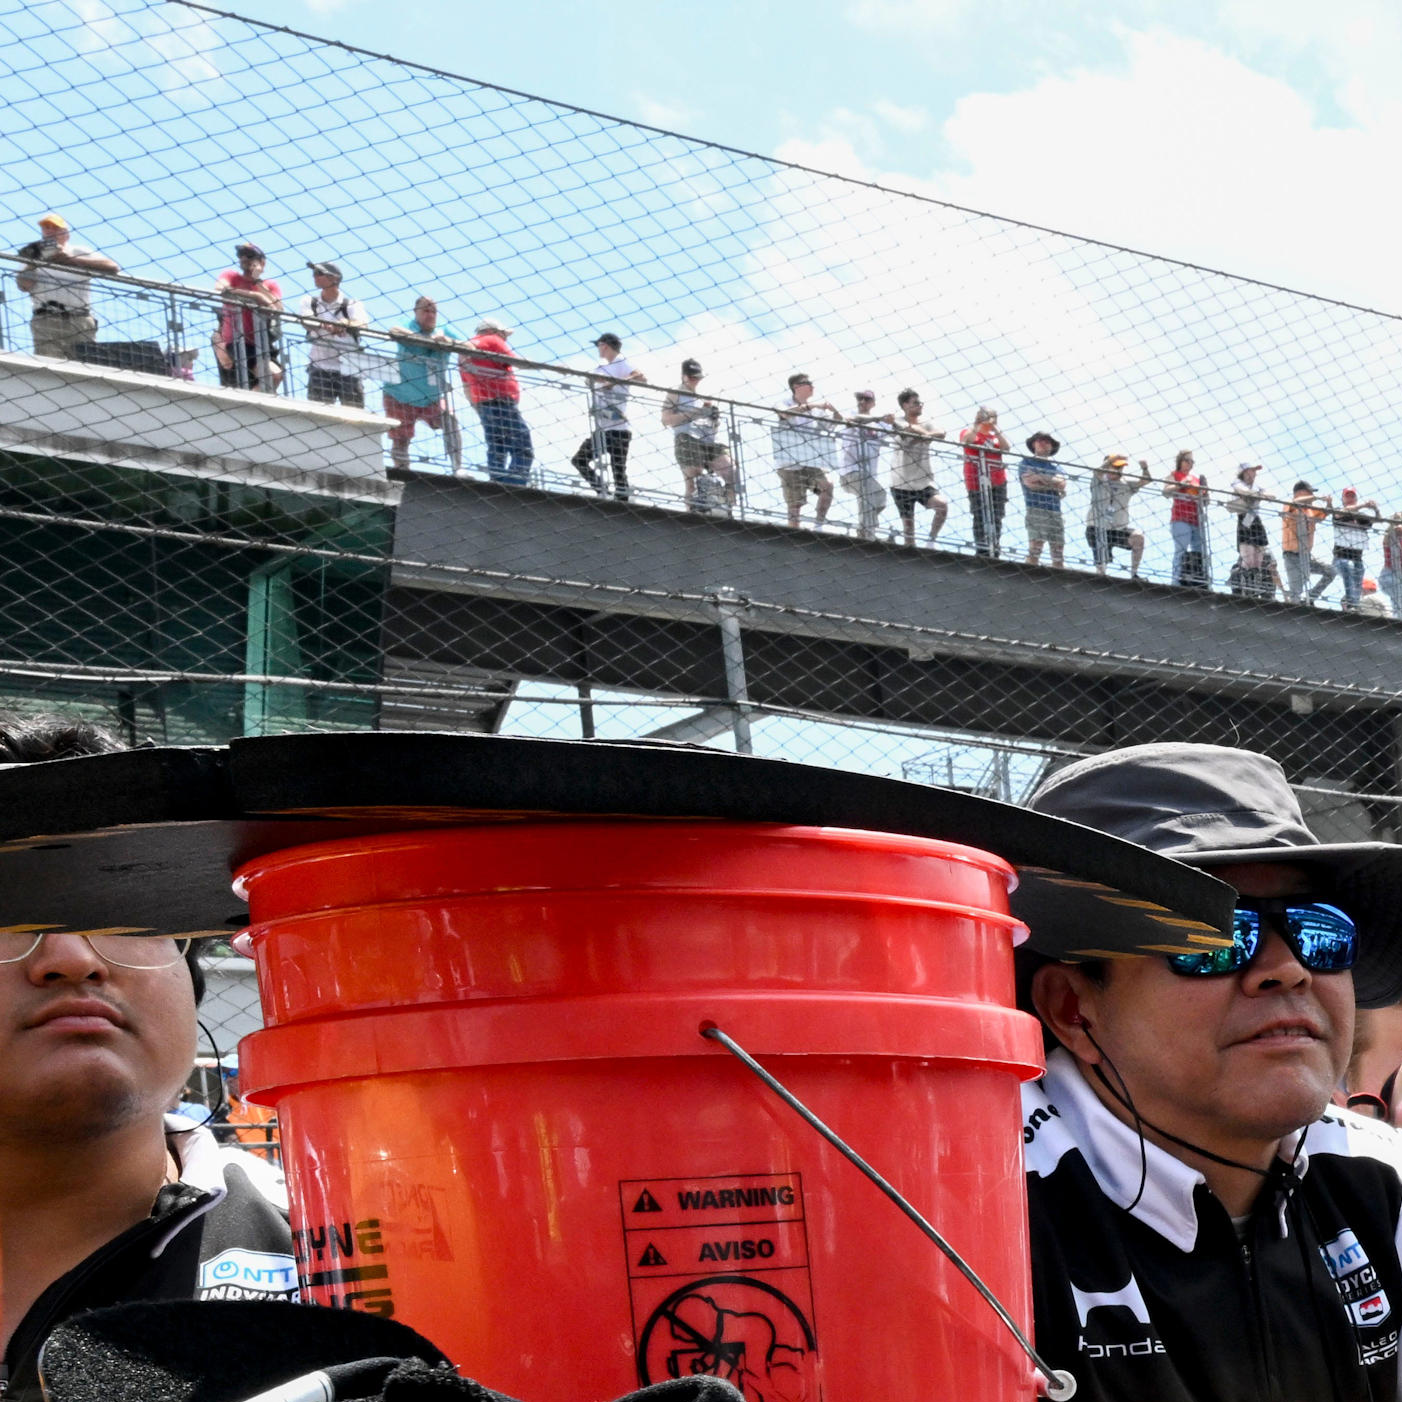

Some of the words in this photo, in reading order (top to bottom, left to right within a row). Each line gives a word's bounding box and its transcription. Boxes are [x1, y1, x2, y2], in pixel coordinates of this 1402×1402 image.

[677, 1186, 795, 1210] WARNING
[698, 1239, 775, 1262] AVISO
[243, 1266, 294, 1284] NTT
